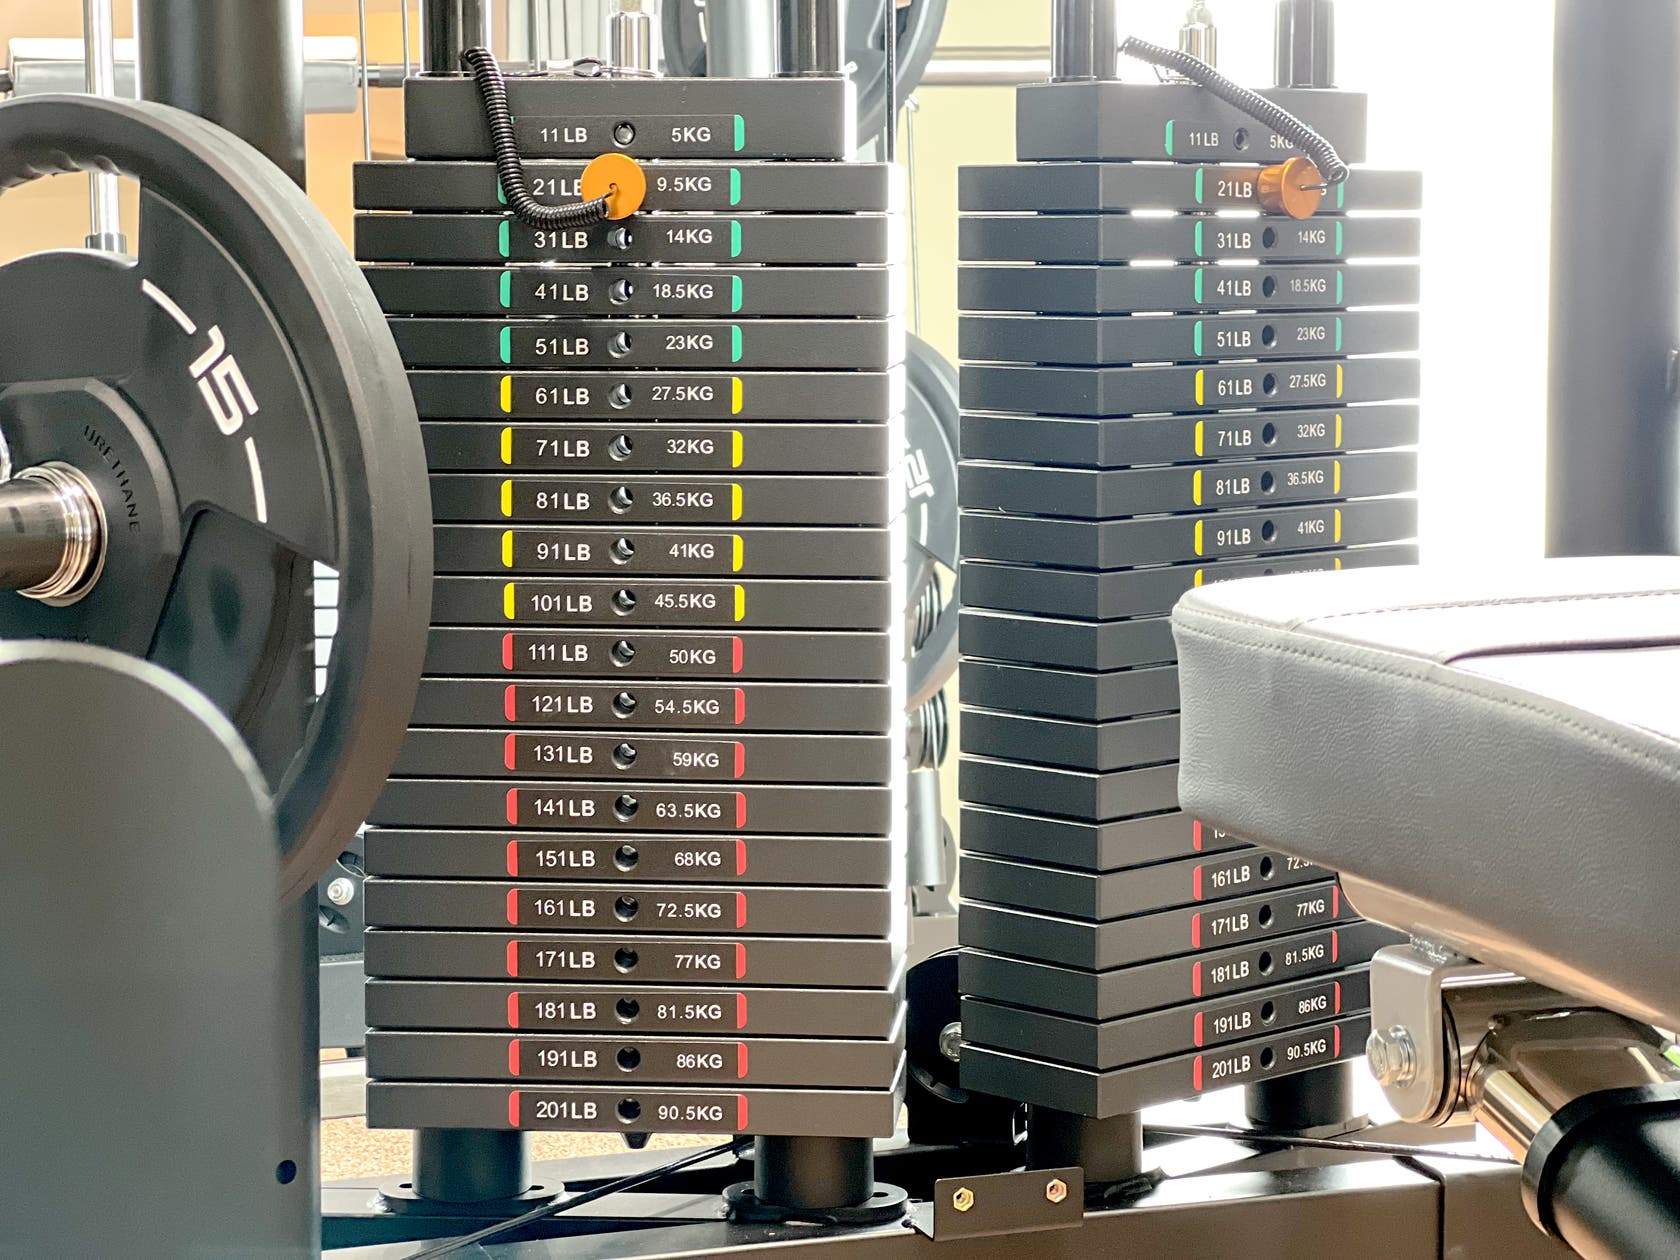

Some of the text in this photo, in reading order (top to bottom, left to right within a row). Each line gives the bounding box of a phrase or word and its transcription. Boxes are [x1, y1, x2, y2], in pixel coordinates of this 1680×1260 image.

[672, 127, 710, 142] 5KG
[657, 177, 711, 191] 9.5KG
[1218, 181, 1252, 197] 21LB
[535, 229, 712, 248] 31LB 14KG
[1218, 230, 1325, 248] 31LB 14KG
[535, 284, 713, 301] 41LB 18.5KG
[1217, 279, 1326, 296] 41LB 18.5KG
[536, 335, 713, 355] 51LB 23KG
[1218, 327, 1325, 347] 51LB 23KG
[189, 325, 259, 436] 15
[1219, 374, 1326, 395] 61LB 27.5KG
[536, 386, 713, 404] 61LB 27.5KG
[1218, 424, 1325, 446] 71LB 32KG
[537, 440, 713, 457] 71LB 32KG
[83, 424, 141, 534] URETHANE
[1216, 470, 1323, 495] 81LB 36.5KG
[537, 492, 713, 509] 81LB 36.5KG
[1218, 520, 1324, 545] 91LB 41KG
[538, 543, 714, 560] 91LB 41KG
[532, 594, 715, 612] 101LB 45.5KG
[670, 650, 715, 664] 50KG
[533, 696, 719, 714] 121LB 54.5KG
[534, 745, 719, 767] 131LB 59KG
[535, 799, 720, 818] 141LB 63.5KG
[536, 851, 720, 868] 151LB 68KG
[1212, 866, 1250, 887] 161LB
[535, 900, 721, 918] 161LB 72.5KG
[1212, 900, 1324, 935] 171LB 77KG
[536, 951, 720, 969] 171LB 77KG
[1212, 944, 1323, 983] 181LB 81.5KG
[535, 1002, 721, 1019] 181LB 81.5KG
[1214, 996, 1326, 1033] 191LB 86KG
[538, 1050, 722, 1068] 191LB 86KG
[1213, 1039, 1326, 1078] 201LB 90.5KG
[537, 1102, 722, 1120] 201LB 90.5KG
